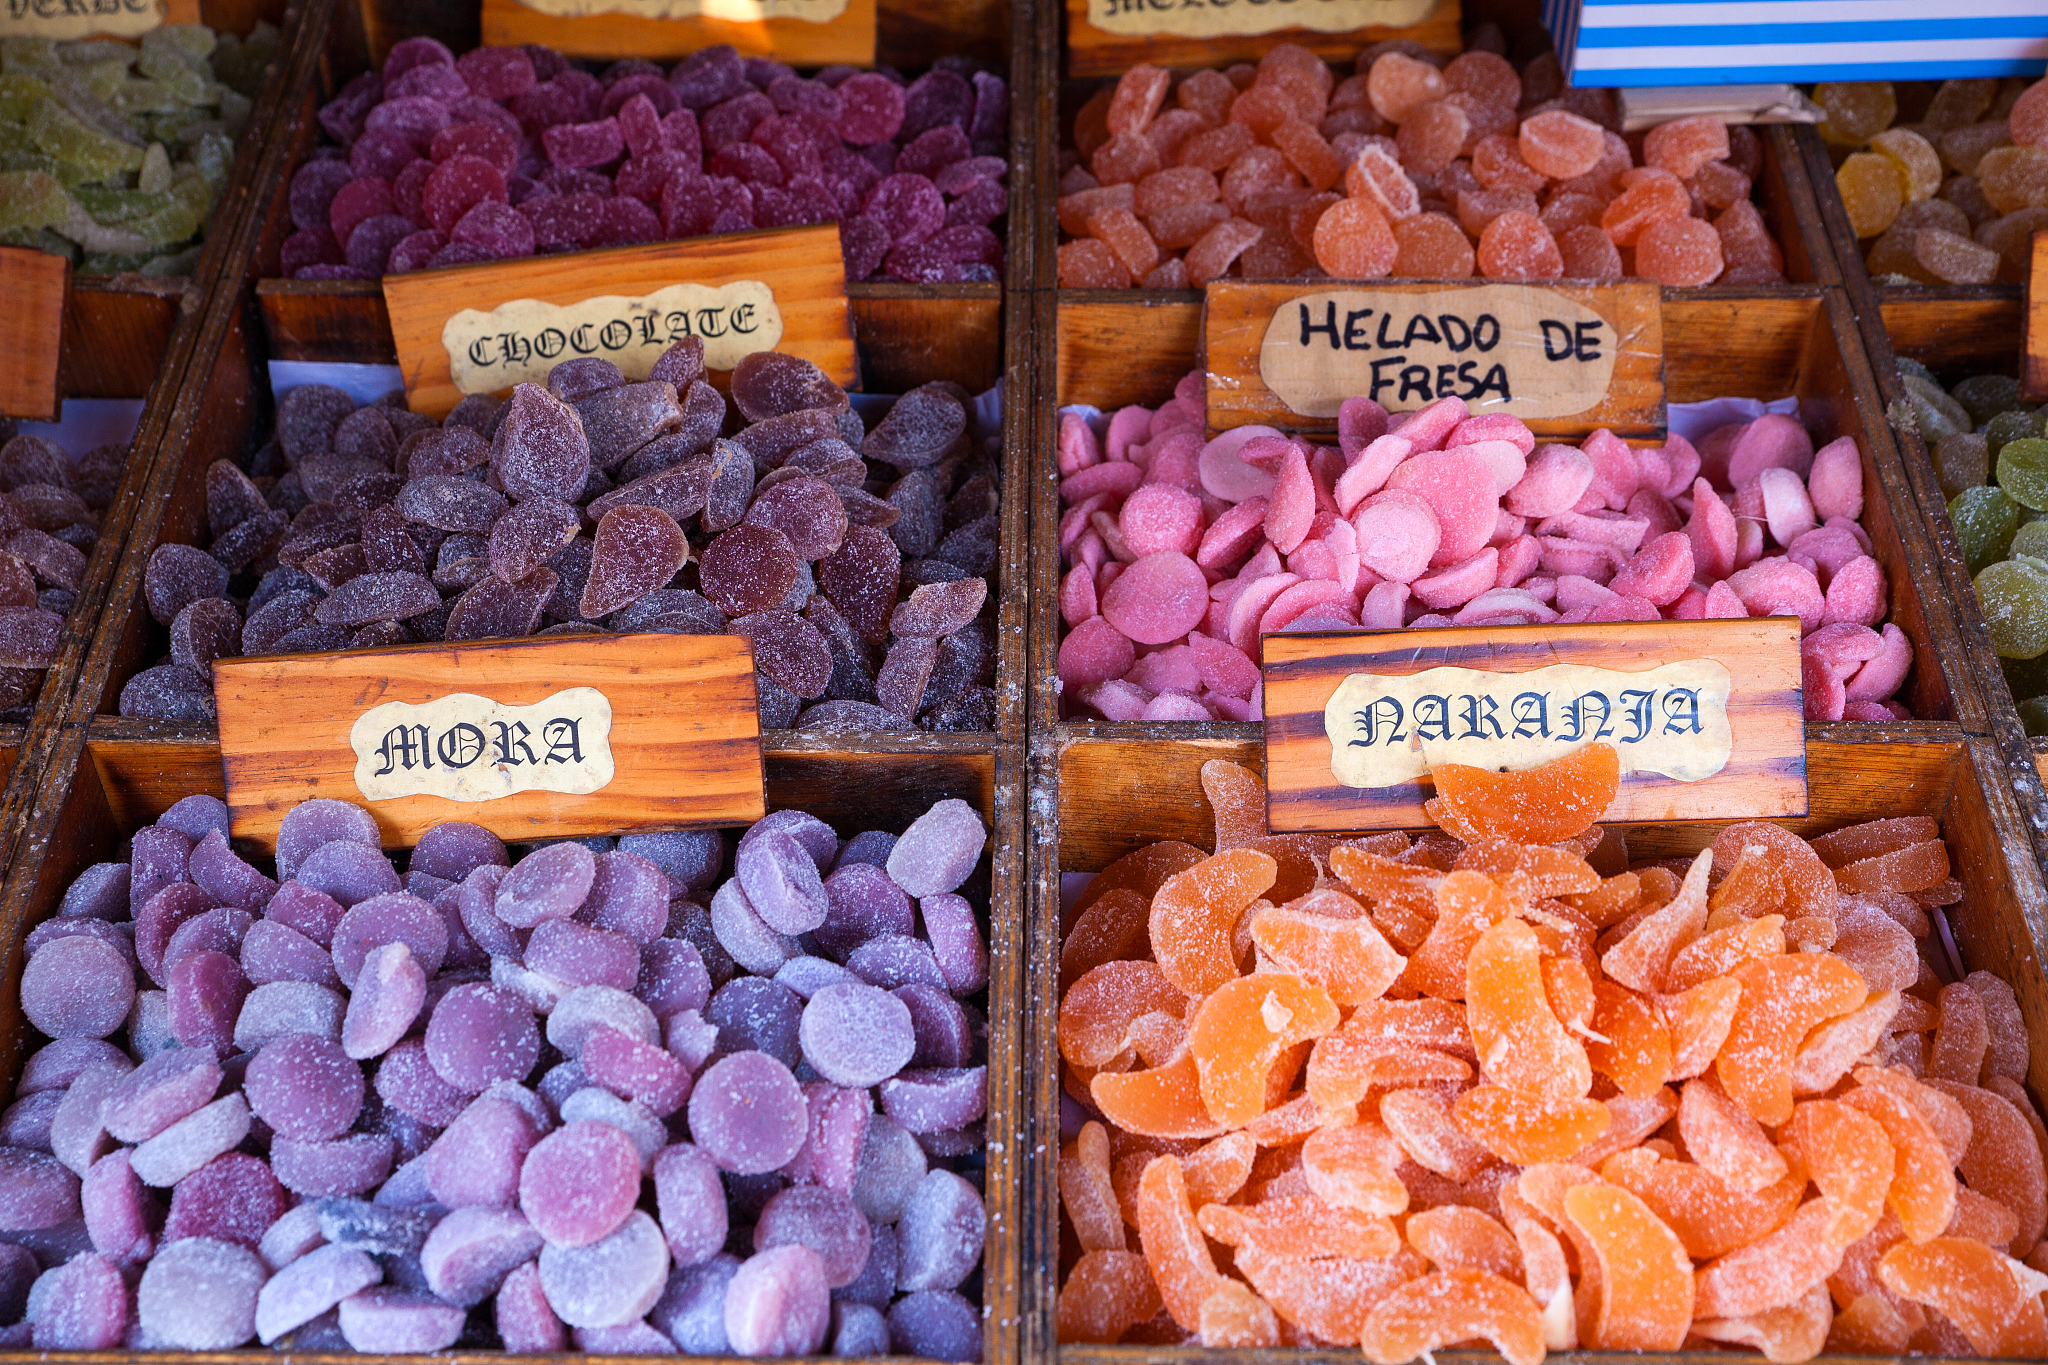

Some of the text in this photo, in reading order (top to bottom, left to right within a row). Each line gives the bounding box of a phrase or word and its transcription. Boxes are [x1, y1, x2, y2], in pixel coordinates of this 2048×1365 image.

[469, 303, 759, 367] CHOCOLATE
[1299, 300, 1604, 362] HELADO DE
[1369, 355, 1512, 403] FRESA
[374, 716, 586, 778] MORA
[1347, 687, 1705, 748] NARANJA
